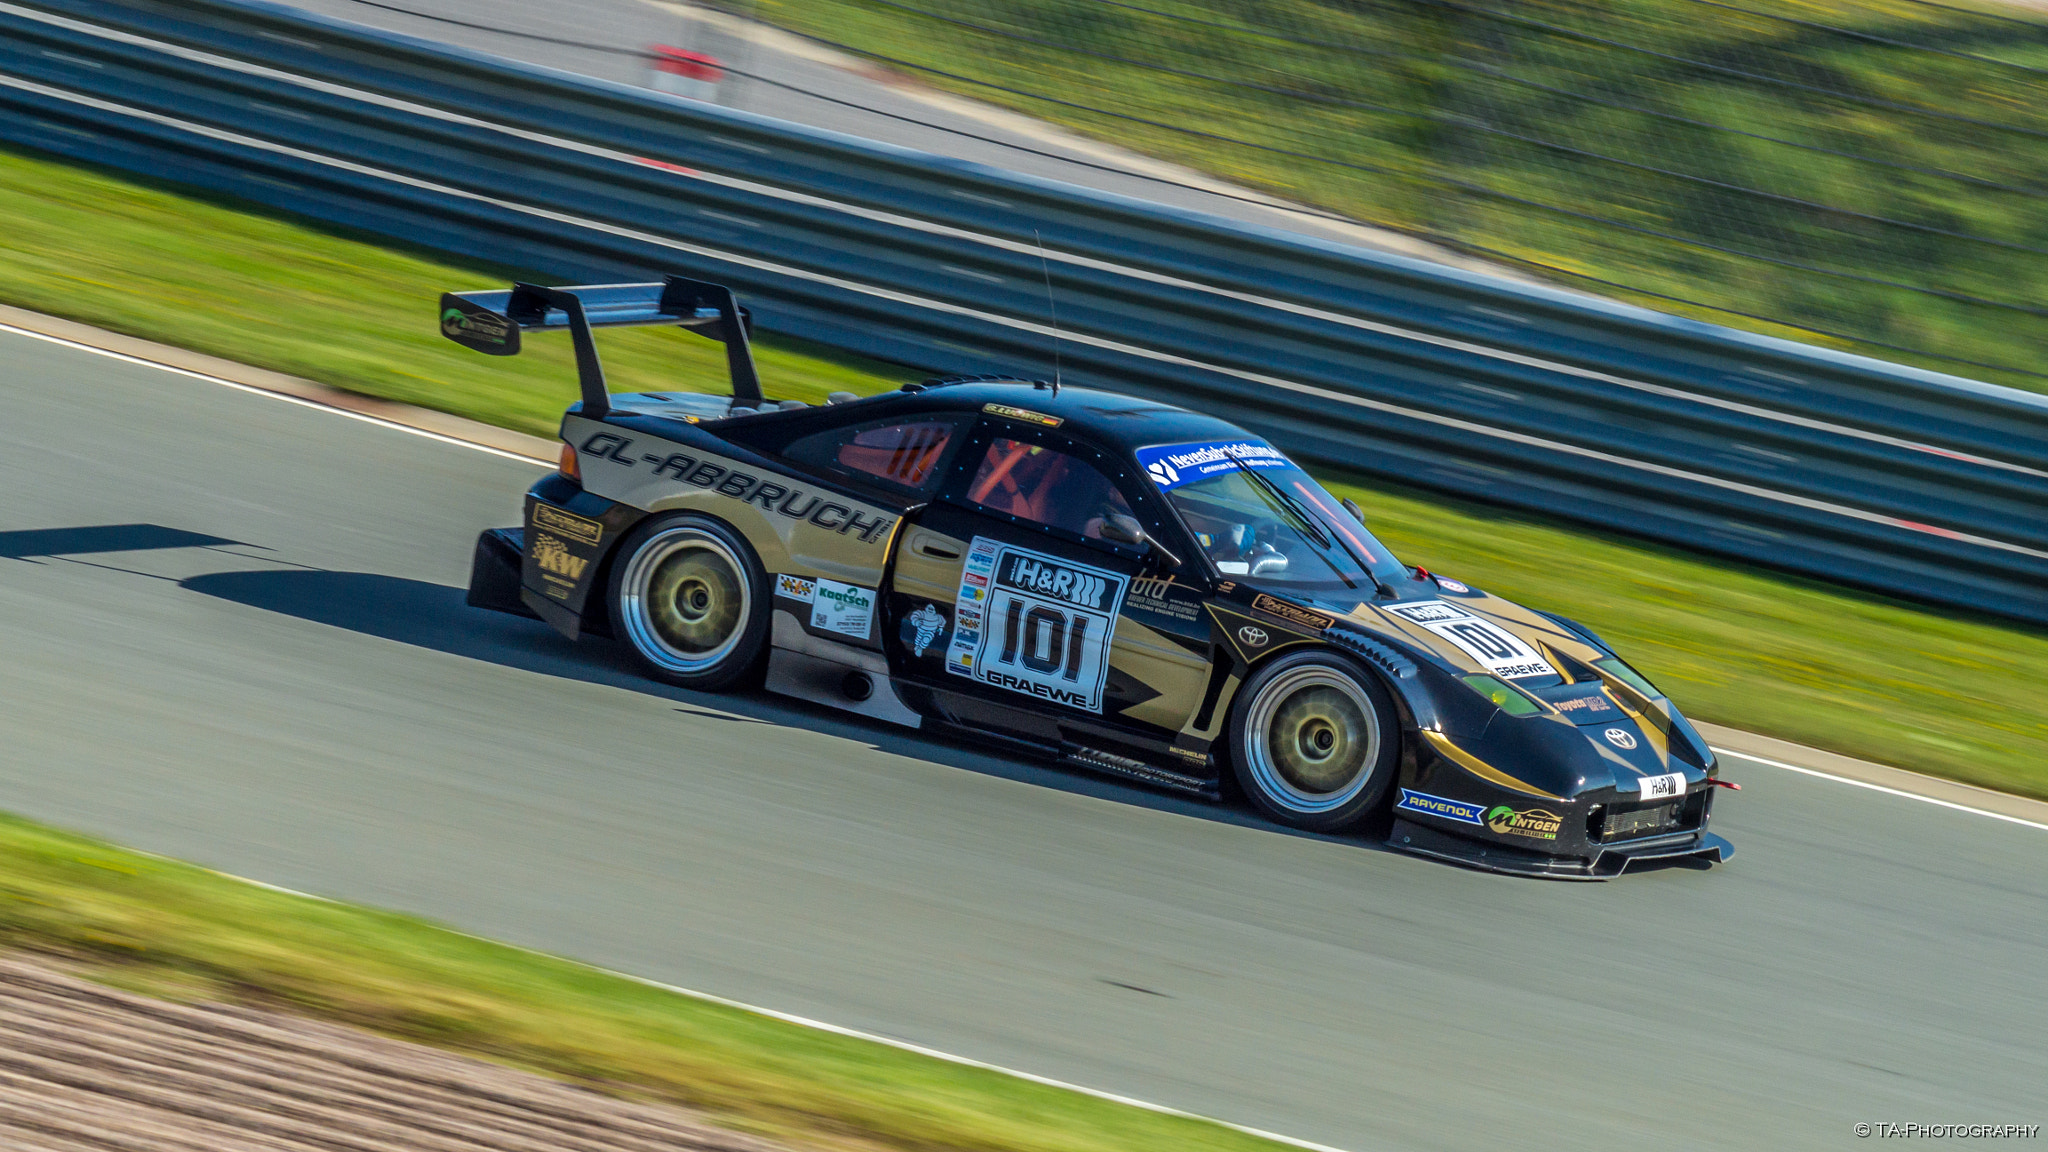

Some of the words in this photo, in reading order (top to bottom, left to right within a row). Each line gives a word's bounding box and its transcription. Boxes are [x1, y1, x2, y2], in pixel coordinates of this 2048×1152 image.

[580, 431, 886, 543] GL-ABBRUCH
[538, 548, 589, 580] KW
[1014, 557, 1075, 601] H&R
[819, 587, 869, 608] Kaatsch
[1130, 567, 1176, 600] btd
[999, 597, 1089, 683] 101
[1441, 622, 1524, 660] 101
[1495, 663, 1547, 677] GRAEWE
[986, 670, 1086, 708] GRAEWE
[1553, 697, 1587, 712] Toyota
[1169, 746, 1207, 760] MICHELIN
[1650, 776, 1668, 795] H&R
[1409, 796, 1475, 818] RAVENOL
